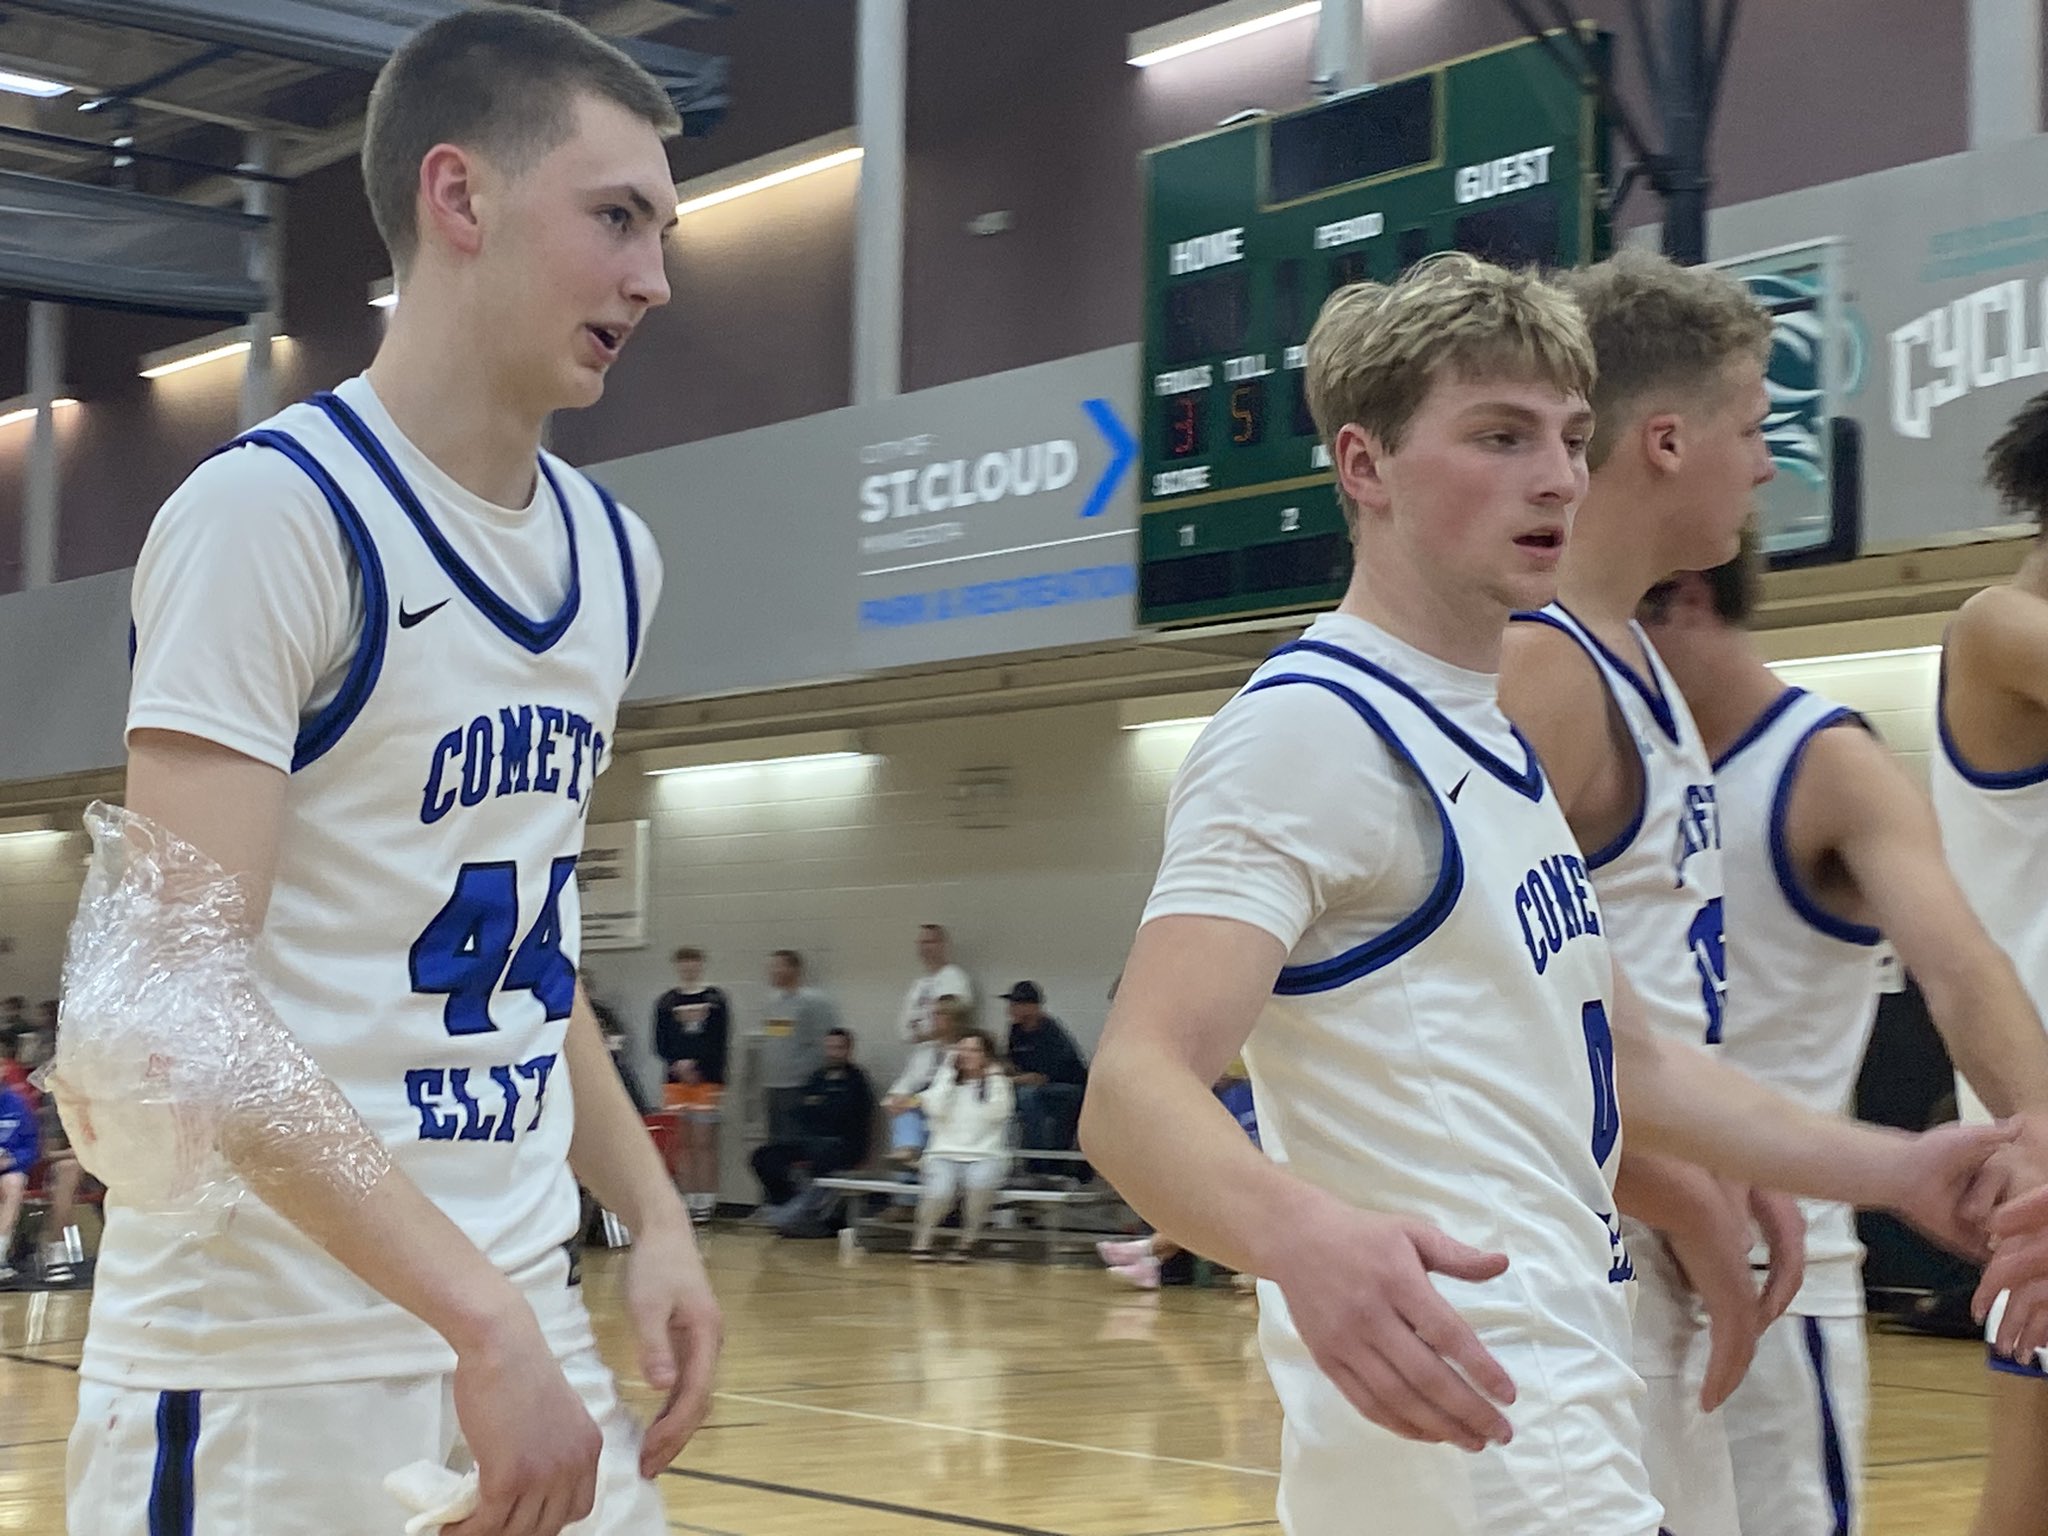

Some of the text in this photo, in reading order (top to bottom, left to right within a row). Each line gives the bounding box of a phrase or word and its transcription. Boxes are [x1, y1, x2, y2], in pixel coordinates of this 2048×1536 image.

[1455, 146, 1554, 204] GUEST
[1169, 227, 1245, 276] HOME
[1231, 384, 1253, 443] 5
[1178, 524, 1196, 547] 1
[1280, 507, 1301, 532] 2
[408, 855, 577, 1037] 44
